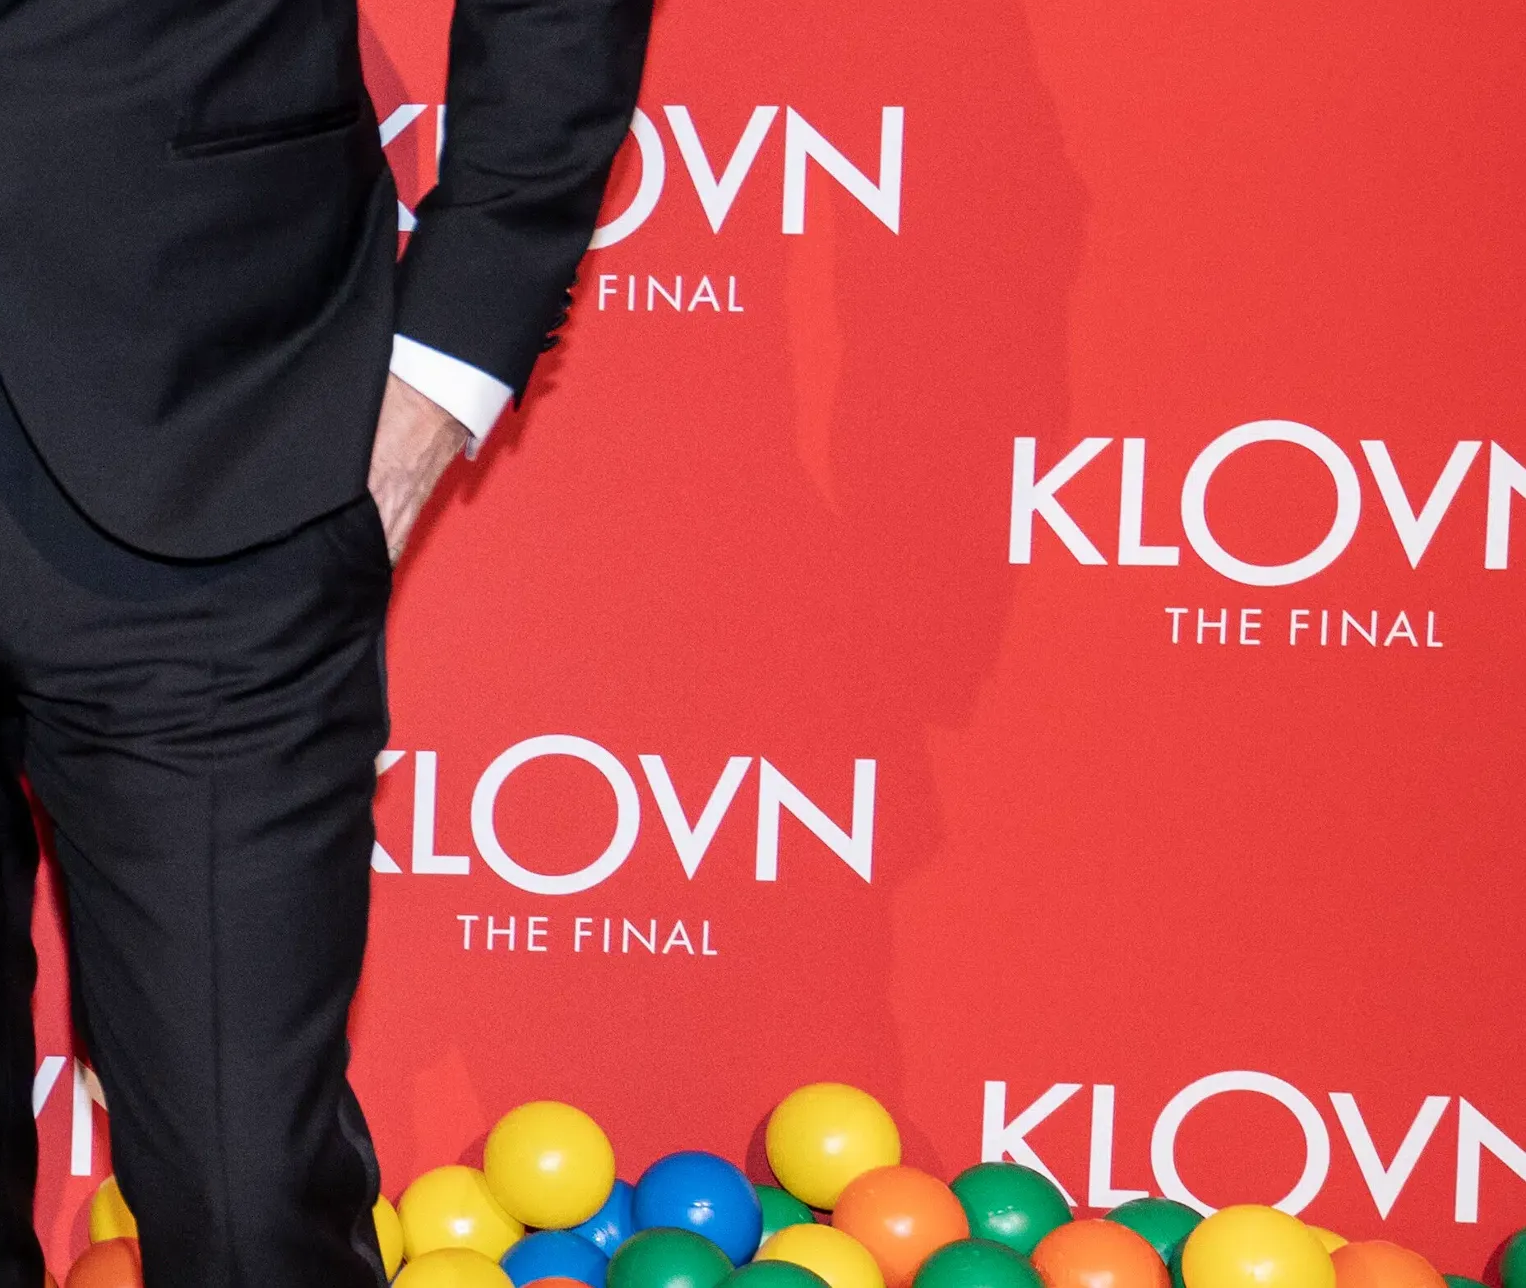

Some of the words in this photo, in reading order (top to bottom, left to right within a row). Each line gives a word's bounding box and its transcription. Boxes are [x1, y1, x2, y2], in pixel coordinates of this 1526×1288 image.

[599, 274, 745, 313] FINAL
[1165, 607, 1263, 646] THE
[1289, 608, 1444, 649] FINAL
[456, 914, 549, 952] THE
[573, 916, 718, 956] FINAL
